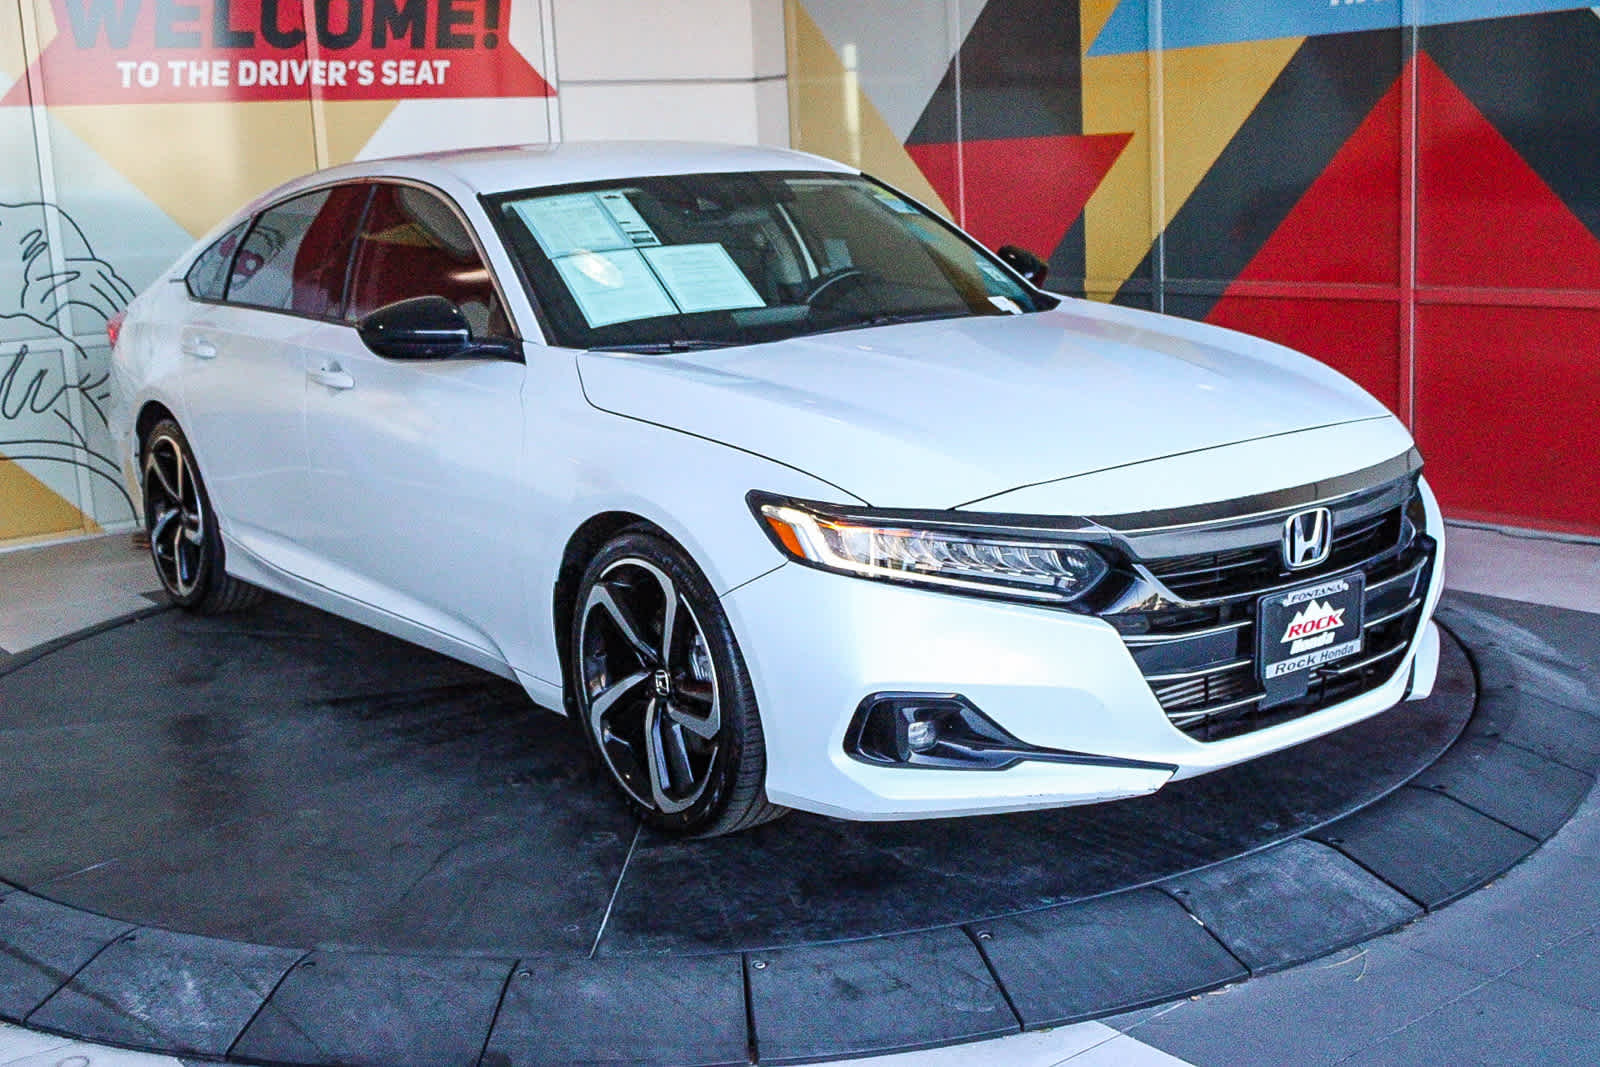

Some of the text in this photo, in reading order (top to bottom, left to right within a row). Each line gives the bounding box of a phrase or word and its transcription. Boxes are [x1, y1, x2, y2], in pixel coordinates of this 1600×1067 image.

[117, 59, 450, 88] TO THE DRIVER'S SEAT
[1288, 613, 1339, 638] ROCK
[1275, 644, 1355, 675] Rock Honda
